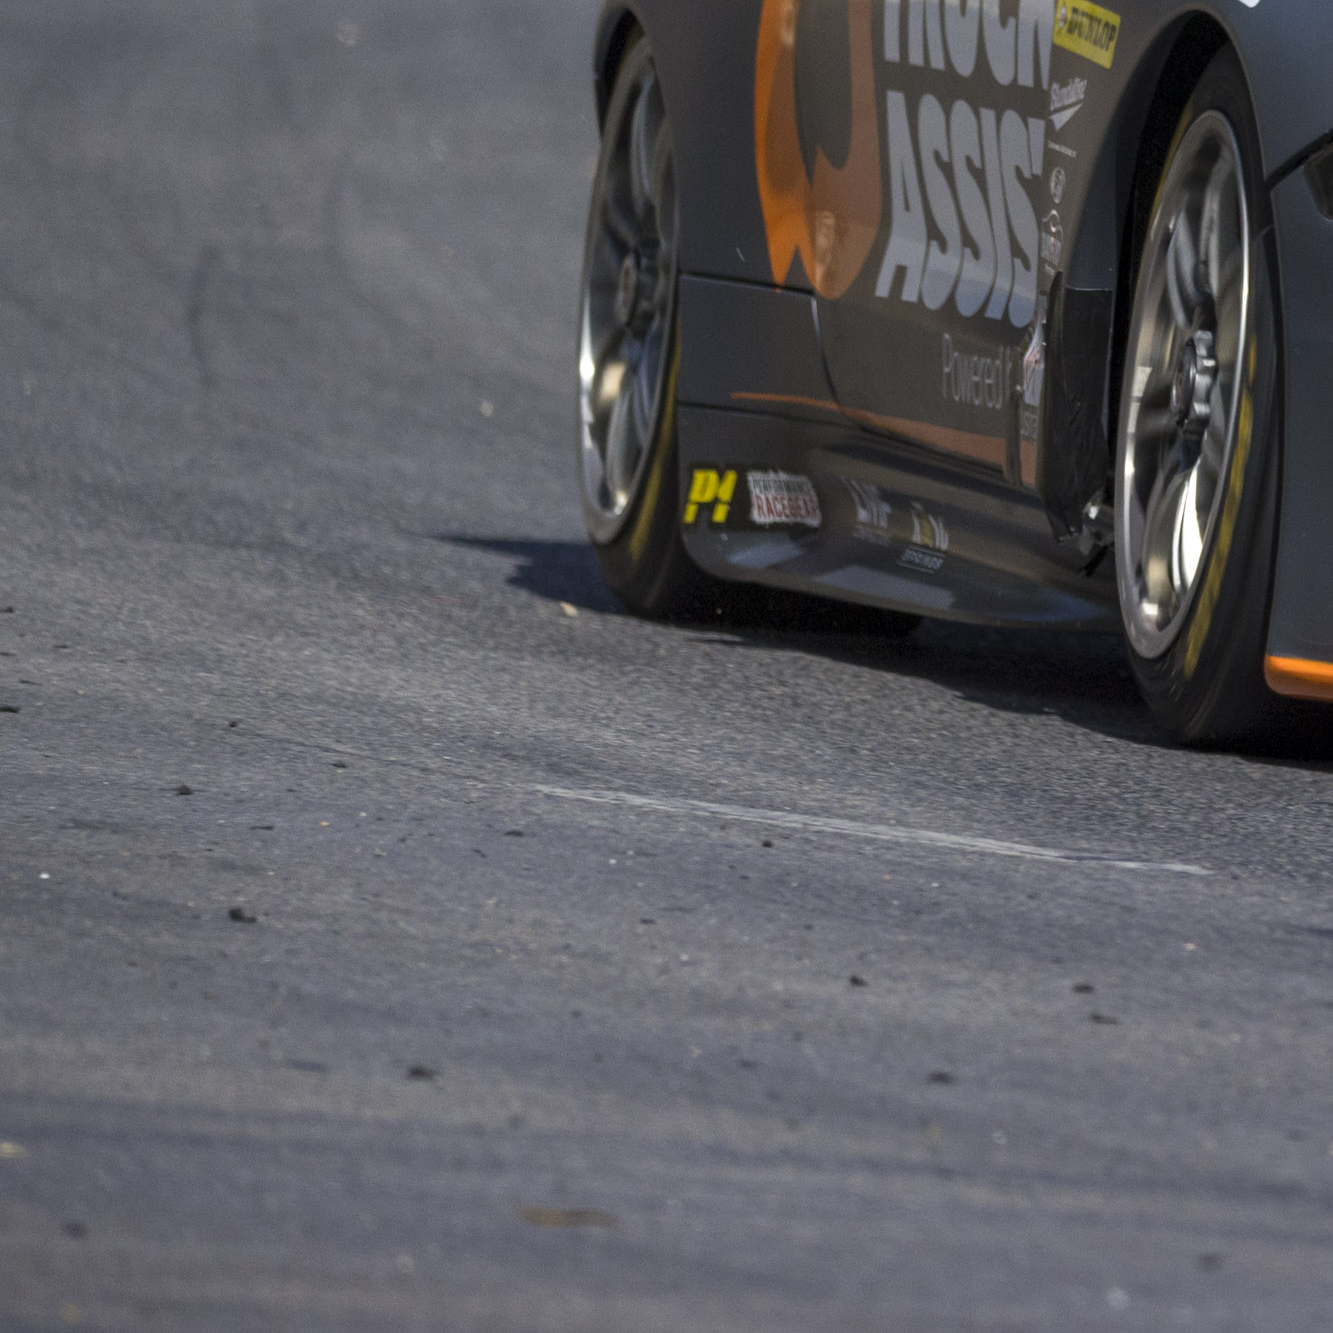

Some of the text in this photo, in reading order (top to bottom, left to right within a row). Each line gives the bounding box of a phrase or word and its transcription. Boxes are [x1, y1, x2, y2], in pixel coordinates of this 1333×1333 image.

[1066, 5, 1118, 53] DUNLOP
[941, 333, 1005, 410] Powered
[754, 493, 820, 520] RACEGEAR
